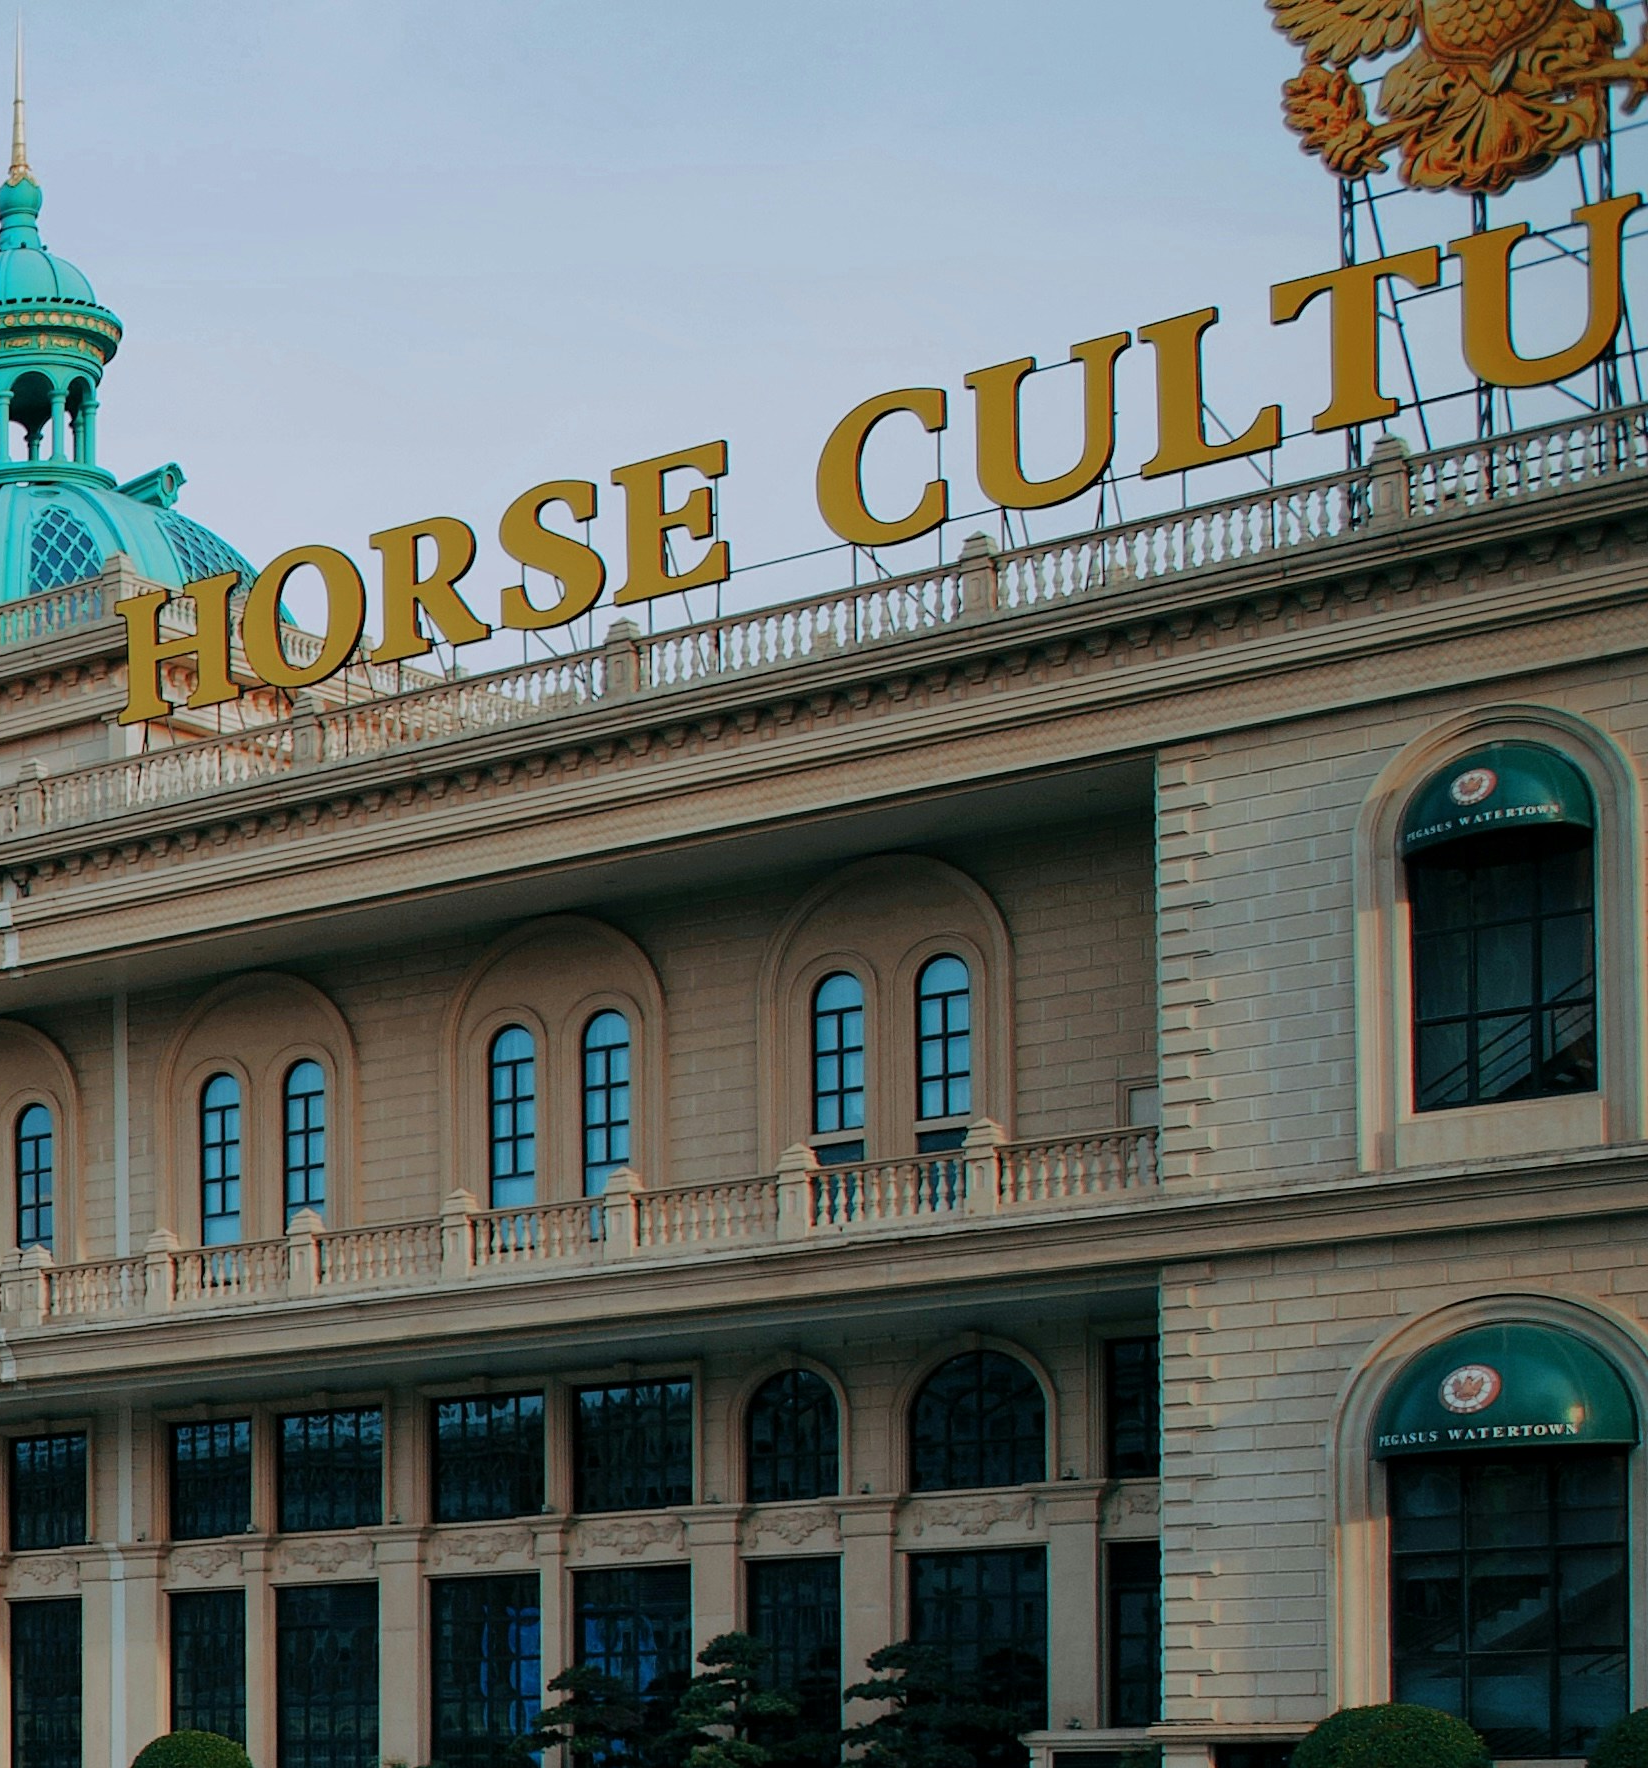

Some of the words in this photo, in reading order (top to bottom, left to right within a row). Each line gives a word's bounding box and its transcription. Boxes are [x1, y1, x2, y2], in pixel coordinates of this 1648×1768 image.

[116, 440, 730, 727] HORSE
[816, 193, 1642, 547] CULTU
[1406, 820, 1453, 842] PEGASUS
[1459, 803, 1560, 826] WATERTOWN
[1379, 1430, 1439, 1447] PEGASUS
[1447, 1422, 1578, 1441] WATERTOWN
